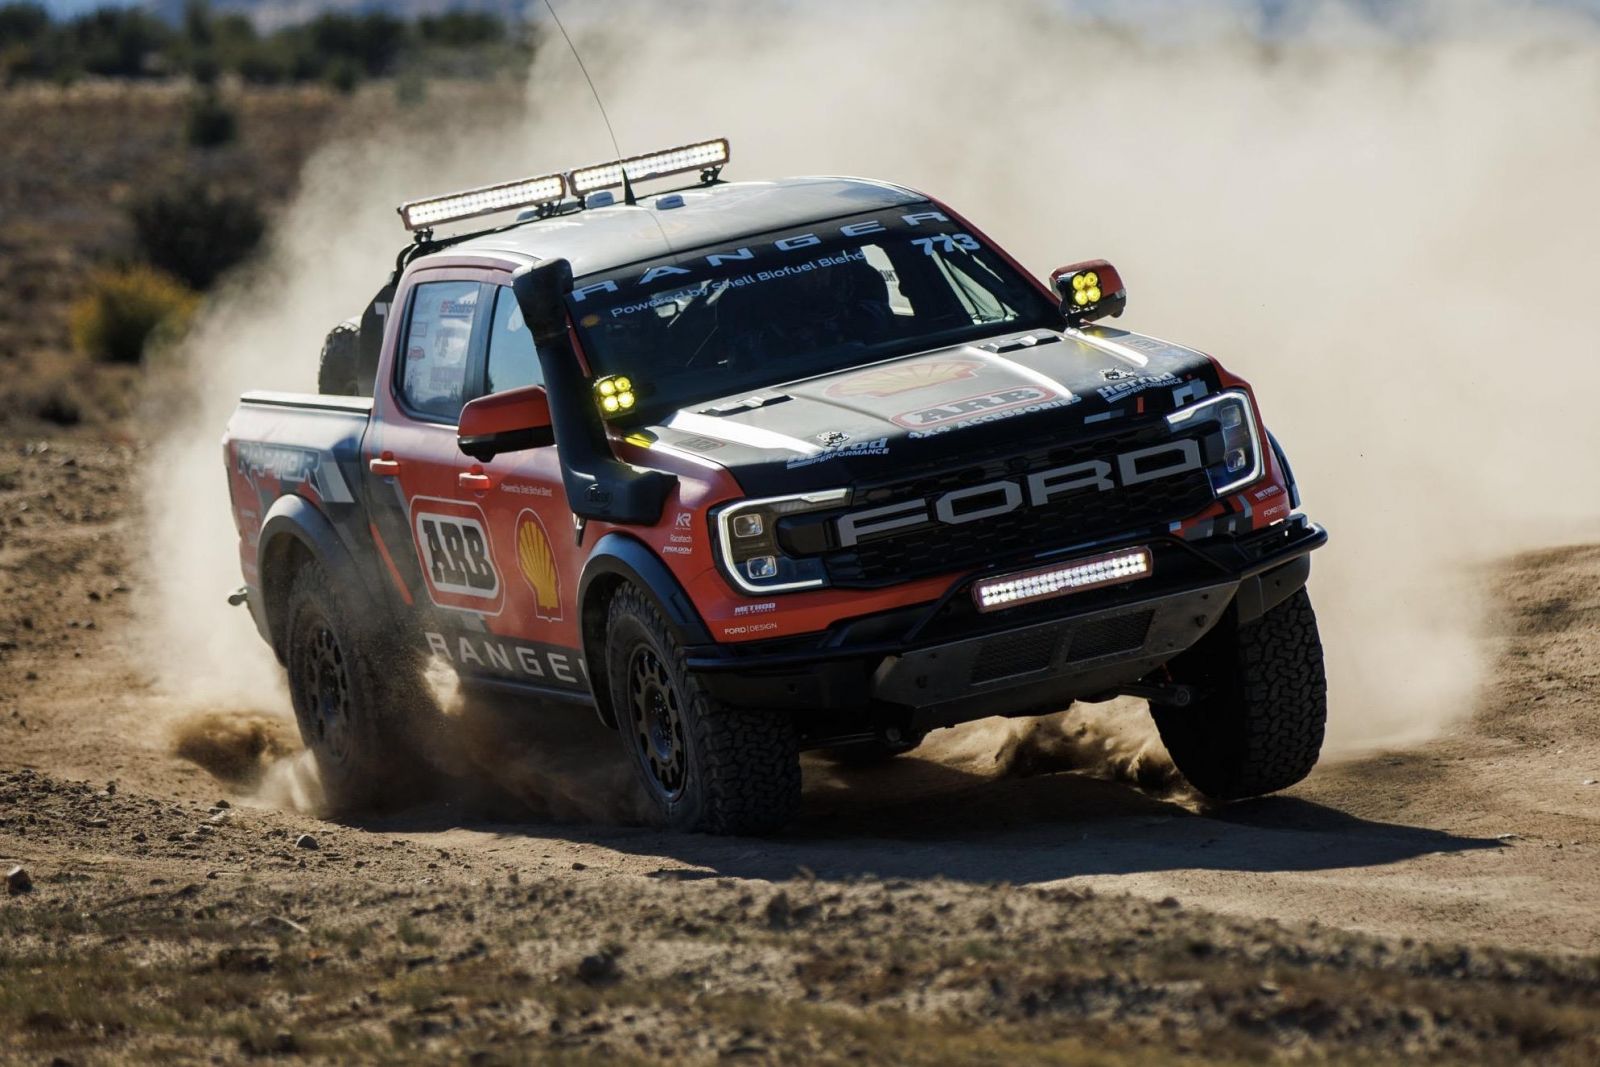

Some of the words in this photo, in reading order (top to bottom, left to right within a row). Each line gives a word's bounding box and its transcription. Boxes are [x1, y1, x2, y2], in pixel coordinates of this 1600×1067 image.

[571, 211, 949, 302] RANGER
[911, 233, 981, 256] 773
[611, 290, 684, 318] Powered
[687, 287, 709, 298] by
[711, 275, 755, 292] Shell
[757, 260, 817, 281] Biofuel
[818, 250, 866, 267] Blend
[912, 389, 1042, 424] ARB
[957, 393, 1082, 429] ACCESSORIES
[813, 447, 890, 464] PERFORMANCE
[836, 439, 1202, 548] FORD
[422, 519, 496, 591] ARB
[735, 602, 776, 612] METHOD
[724, 626, 747, 635] FORD
[749, 622, 777, 632] DESIGN
[425, 631, 588, 683] RANGE
